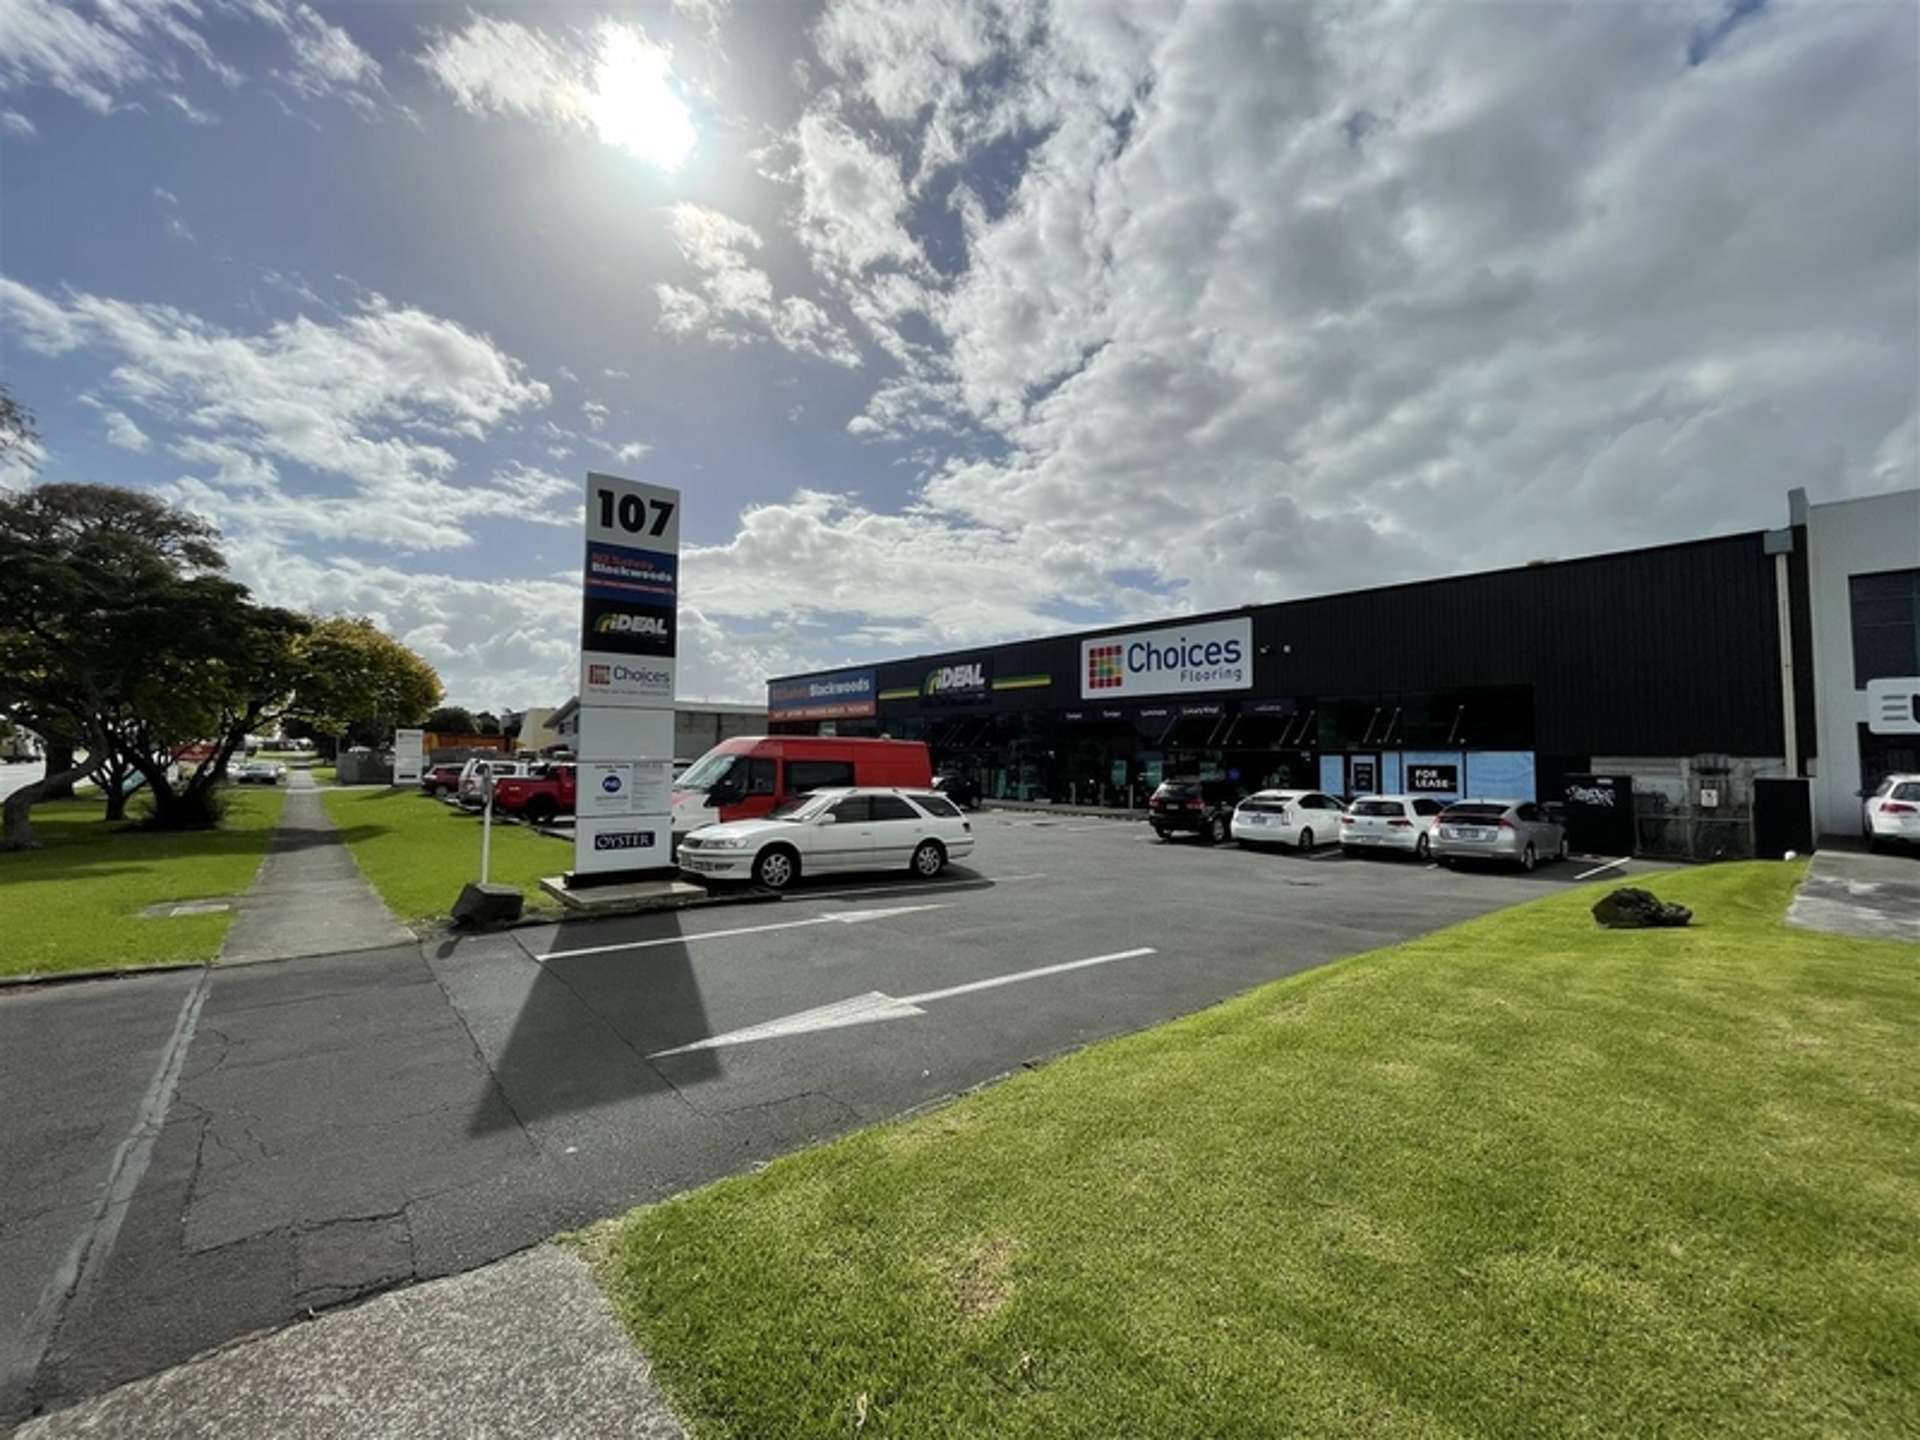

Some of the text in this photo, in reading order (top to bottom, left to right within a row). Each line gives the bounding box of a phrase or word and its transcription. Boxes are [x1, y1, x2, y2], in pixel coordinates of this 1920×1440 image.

[598, 489, 675, 537] 107
[592, 562, 672, 582] Blackwoods
[1128, 637, 1242, 673] Choices
[613, 665, 671, 682] Choices
[1180, 668, 1242, 683] Flooring
[810, 678, 870, 697] Blackwoods
[1415, 769, 1438, 778] FOR
[1415, 778, 1449, 788] LEASE
[597, 835, 651, 848] OYSTER
